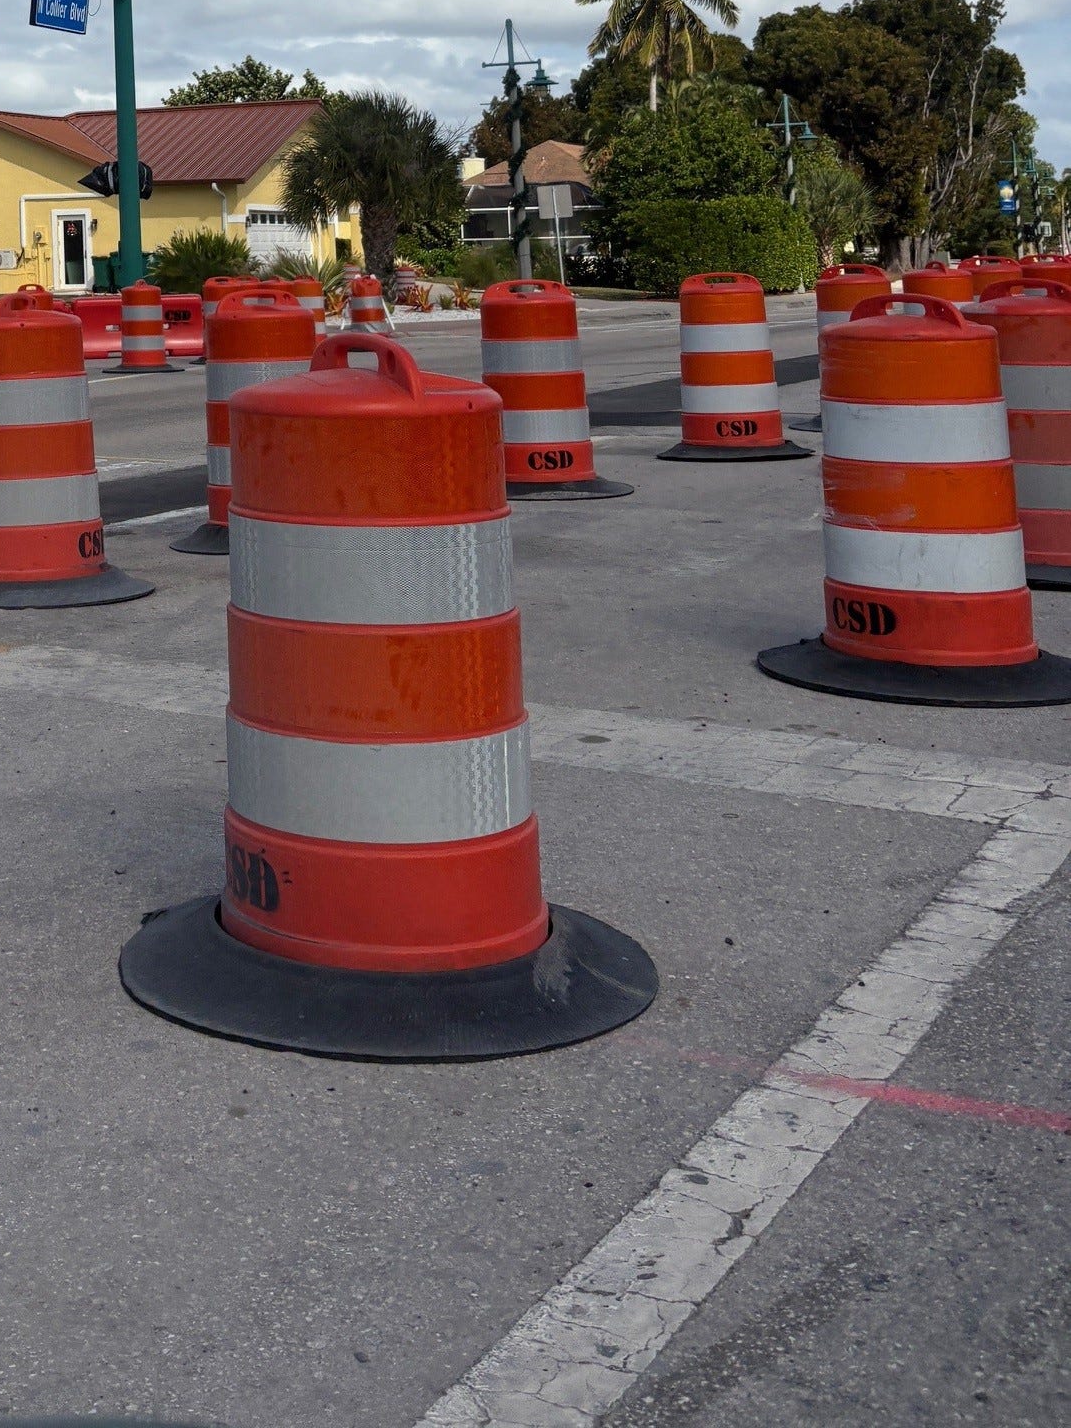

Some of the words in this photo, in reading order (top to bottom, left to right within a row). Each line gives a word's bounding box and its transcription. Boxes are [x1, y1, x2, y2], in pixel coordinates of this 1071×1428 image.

[69, 1, 87, 23] Blvd
[715, 419, 758, 437] CSD
[528, 450, 574, 470] CSD
[78, 529, 104, 559] CS
[833, 597, 896, 636] CSD
[227, 843, 280, 912] SD
